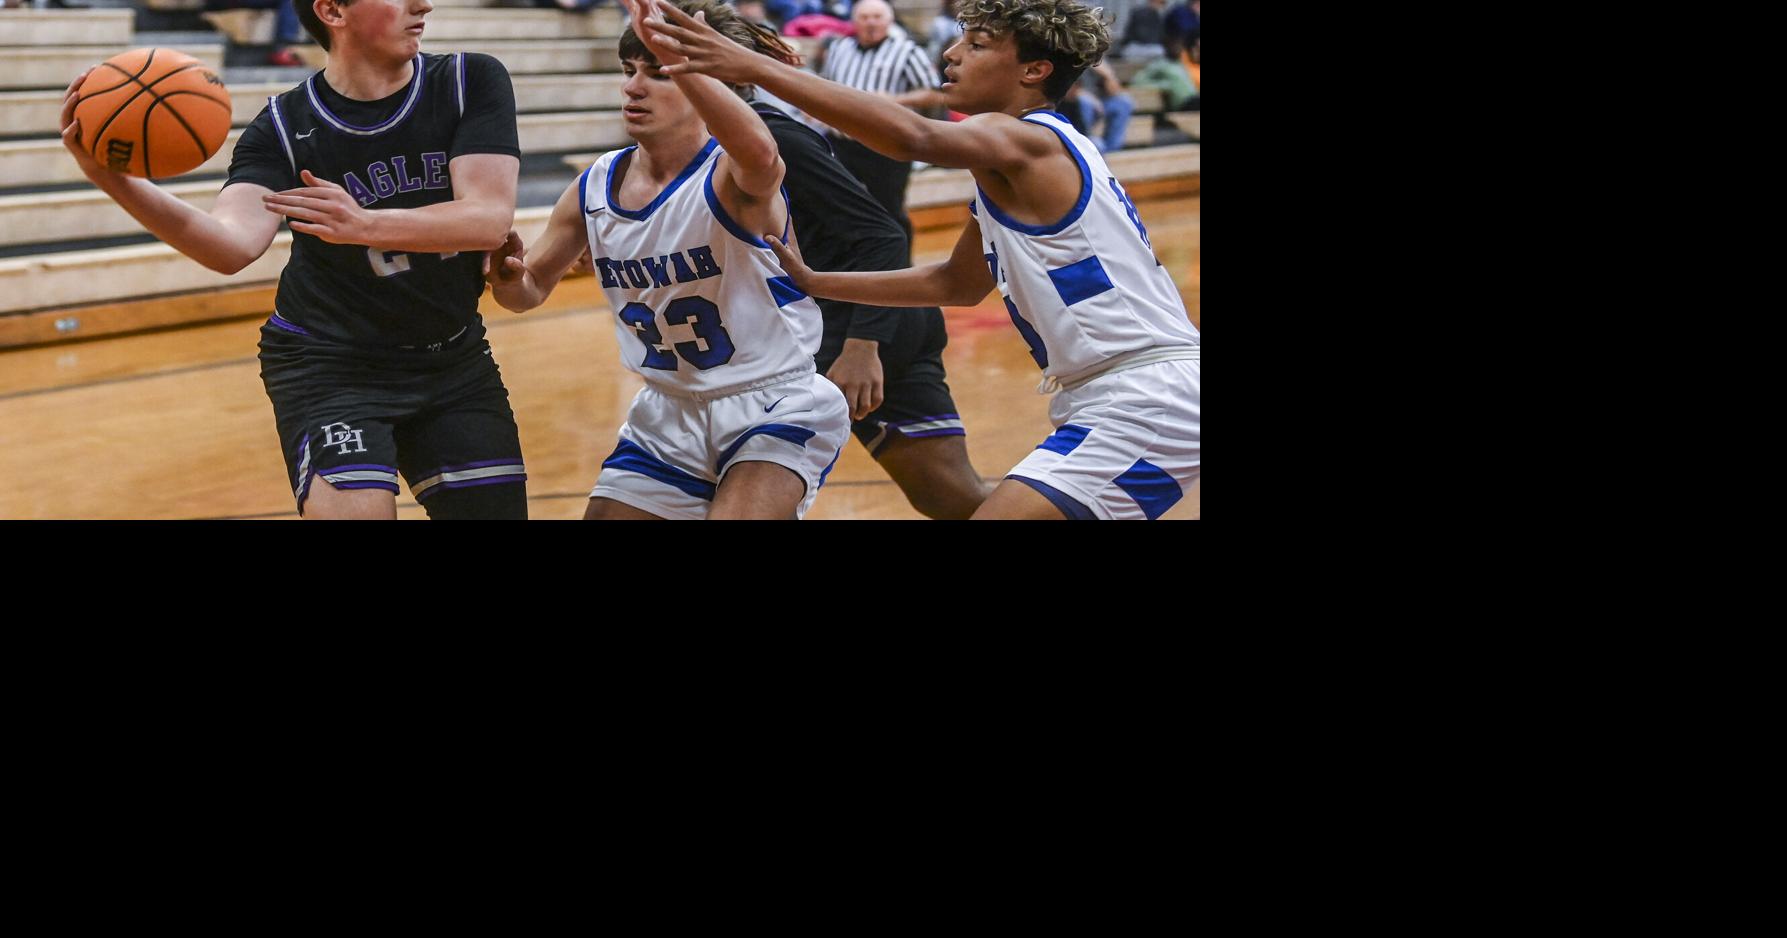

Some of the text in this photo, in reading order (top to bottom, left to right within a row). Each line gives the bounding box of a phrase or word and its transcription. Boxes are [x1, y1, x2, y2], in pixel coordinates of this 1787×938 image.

[344, 152, 449, 207] AGLE
[595, 245, 722, 289] ETOWAH
[619, 295, 736, 371] 23
